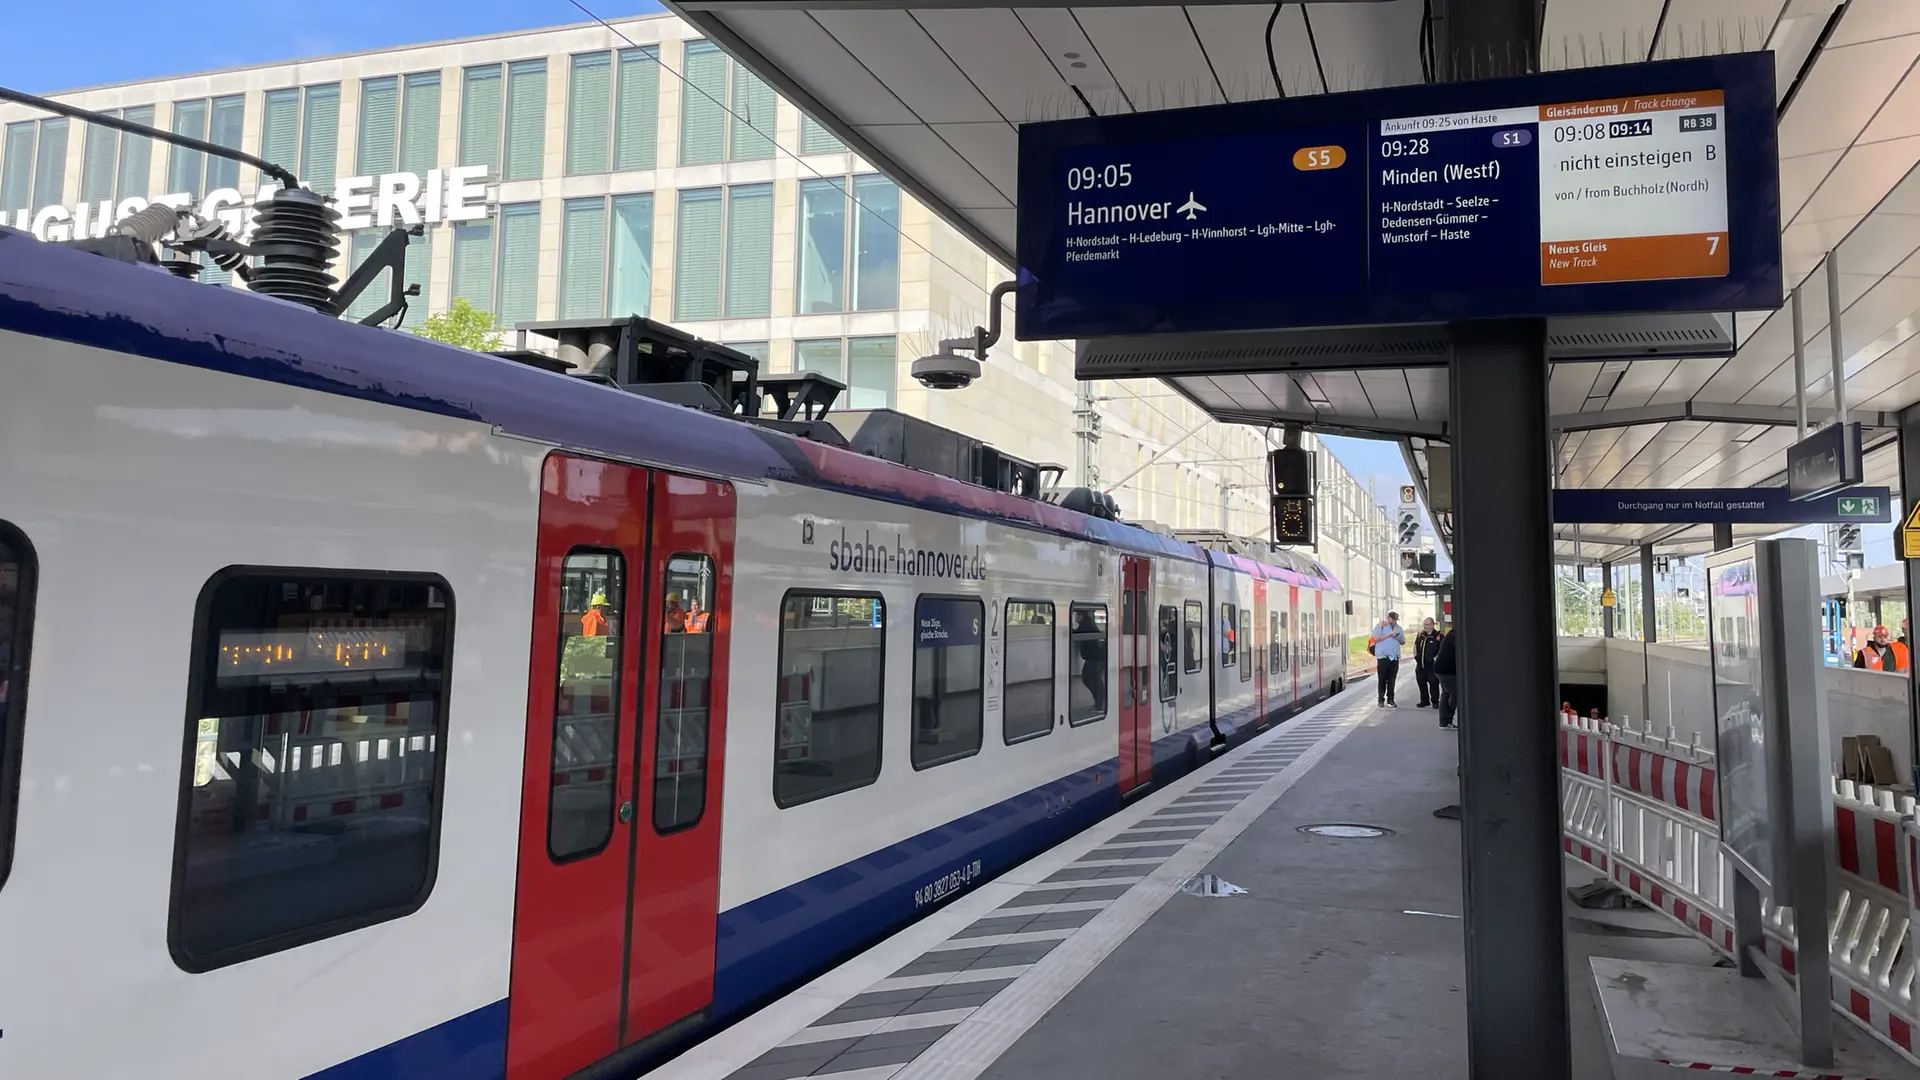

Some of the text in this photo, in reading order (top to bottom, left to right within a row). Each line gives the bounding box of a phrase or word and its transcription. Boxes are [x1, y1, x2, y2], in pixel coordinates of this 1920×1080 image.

[1546, 103, 1619, 118] Gleisänderung
[1633, 99, 1659, 110] Track
[1660, 97, 1697, 108] change
[1384, 114, 1498, 132] Ankunft 09:25 von Haste
[1554, 121, 1651, 143] 09:08 09:14
[1683, 117, 1713, 129] RB 38
[1381, 138, 1429, 157] 09:28
[1705, 145, 1716, 161] B
[1560, 150, 1692, 172] nicht einsteigen
[1067, 163, 1132, 191] 09:05
[1382, 160, 1500, 186] Minden (Westf)
[1555, 192, 1574, 200] von
[1585, 188, 1610, 199] from
[1068, 201, 1172, 226] Hannover
[1382, 198, 1444, 213] H-Nordstadt
[1455, 196, 1490, 208] Seelze
[1382, 213, 1479, 228] Dedensen-Gümmer
[1066, 234, 1120, 248] H-Nordstadt
[1129, 231, 1182, 244] H-Ledeburg
[1191, 226, 1247, 239] H-Vinnhorst
[1257, 222, 1304, 238] Lgh-Mitte
[1314, 220, 1336, 234] Lgh-
[1382, 230, 1428, 244] Wunstorf
[1440, 229, 1470, 241] Haste
[1549, 242, 1608, 255] Neues Gleis
[1706, 236, 1719, 255] 7
[1065, 249, 1120, 263] Pferdemarkt
[1549, 257, 1598, 269] New Track
[1617, 501, 1663, 511] Durchgang
[1695, 501, 1724, 509] Notfall
[1726, 501, 1765, 511] gestattet
[829, 526, 987, 580] sbahn-hannover.de
